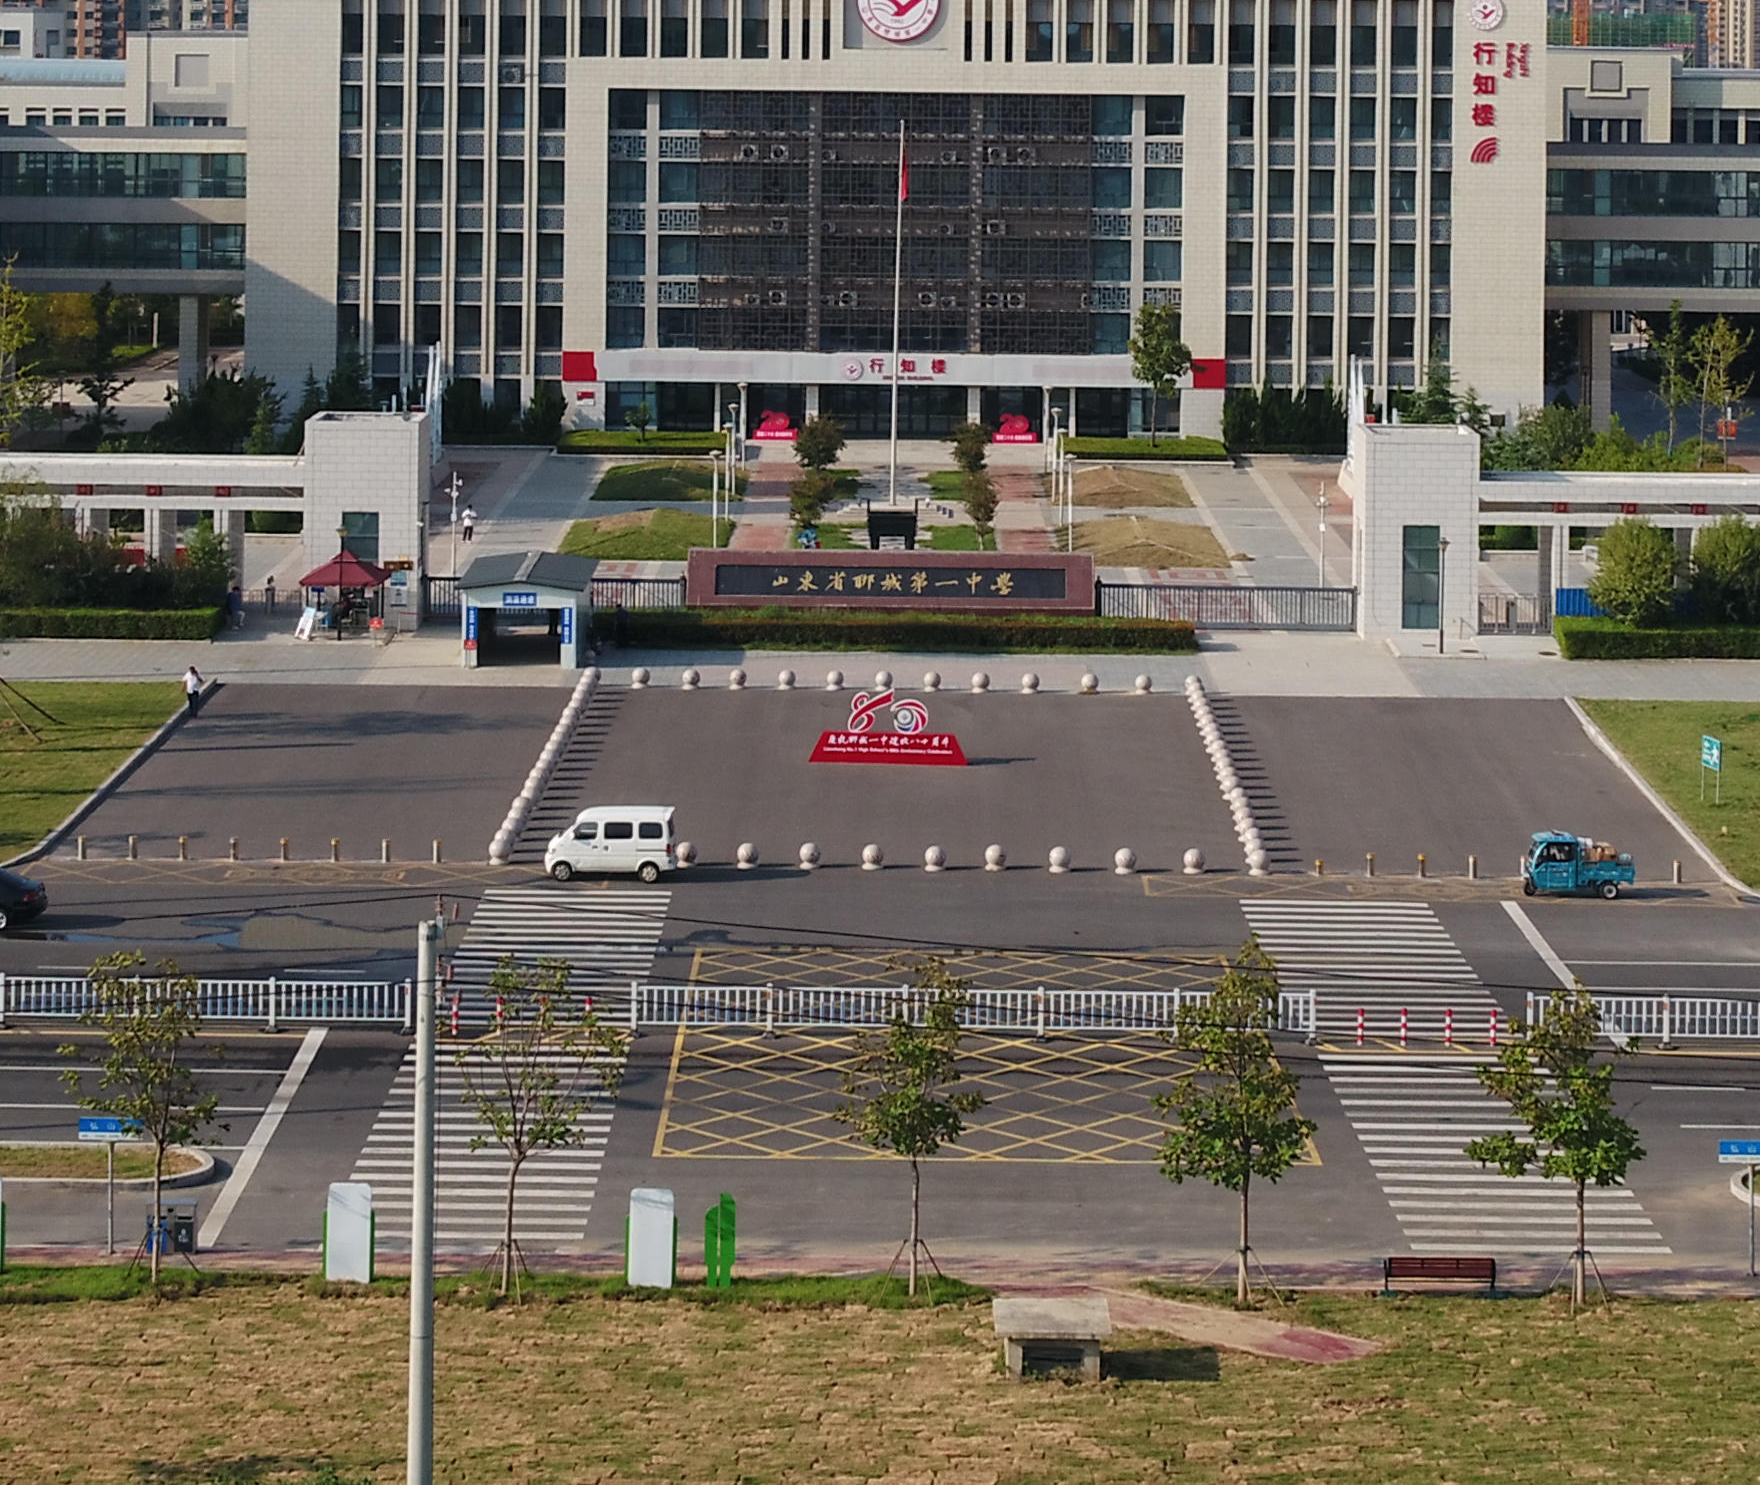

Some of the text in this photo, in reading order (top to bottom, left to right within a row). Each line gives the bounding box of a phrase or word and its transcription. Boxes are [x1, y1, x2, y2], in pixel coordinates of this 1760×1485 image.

[1471, 42, 1497, 127] 行知楼
[869, 358, 947, 374] 行知楼
